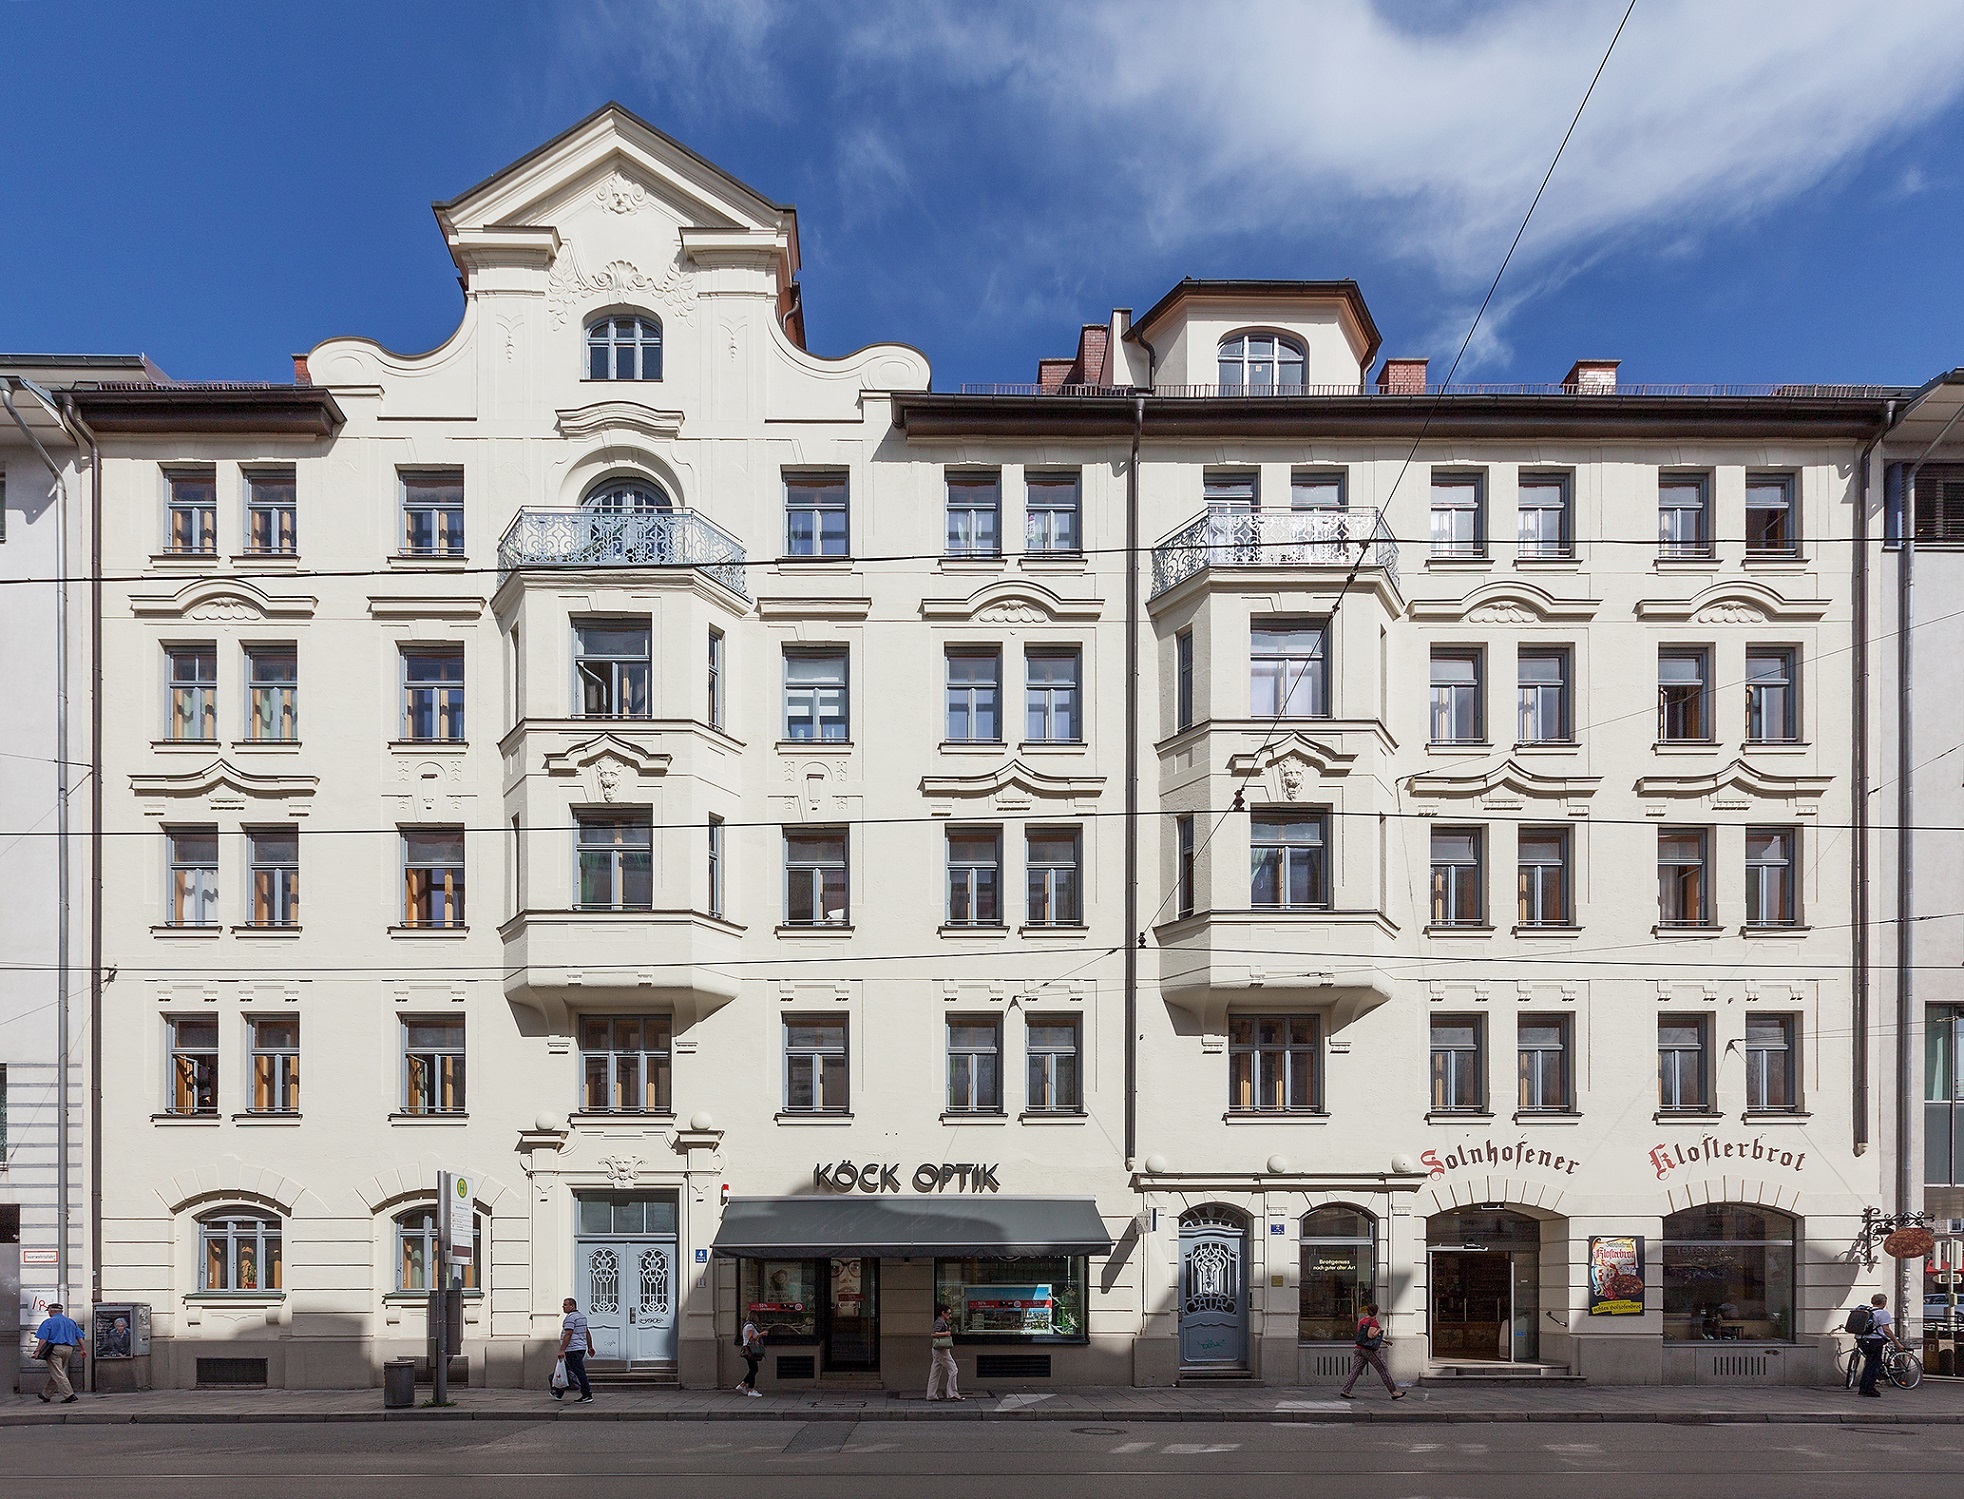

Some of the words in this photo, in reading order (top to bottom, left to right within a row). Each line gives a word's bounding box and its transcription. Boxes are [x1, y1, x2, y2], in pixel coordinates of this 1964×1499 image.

[814, 1160, 901, 1192] KÖCK
[912, 1163, 1000, 1193] OPTIK
[1420, 1139, 1580, 1181] Solnhofener
